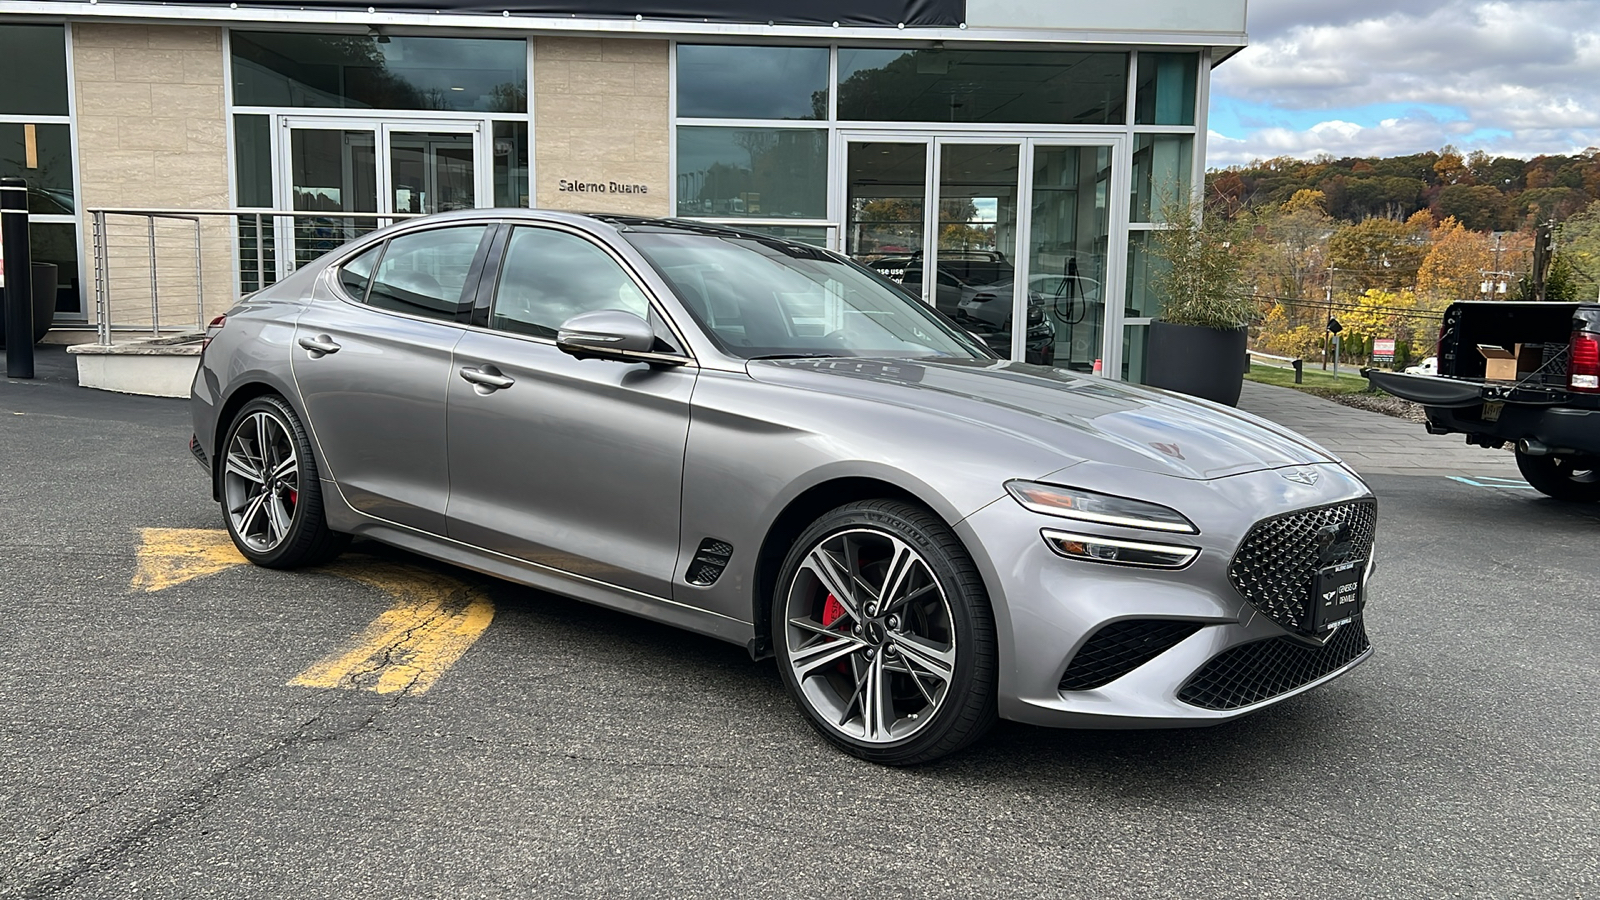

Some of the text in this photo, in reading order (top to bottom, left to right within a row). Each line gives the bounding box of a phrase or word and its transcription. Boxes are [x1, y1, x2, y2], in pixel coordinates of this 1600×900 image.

[559, 180, 648, 194] Salerno Duane
[890, 268, 904, 276] use
[879, 516, 928, 547] MICHELIN
